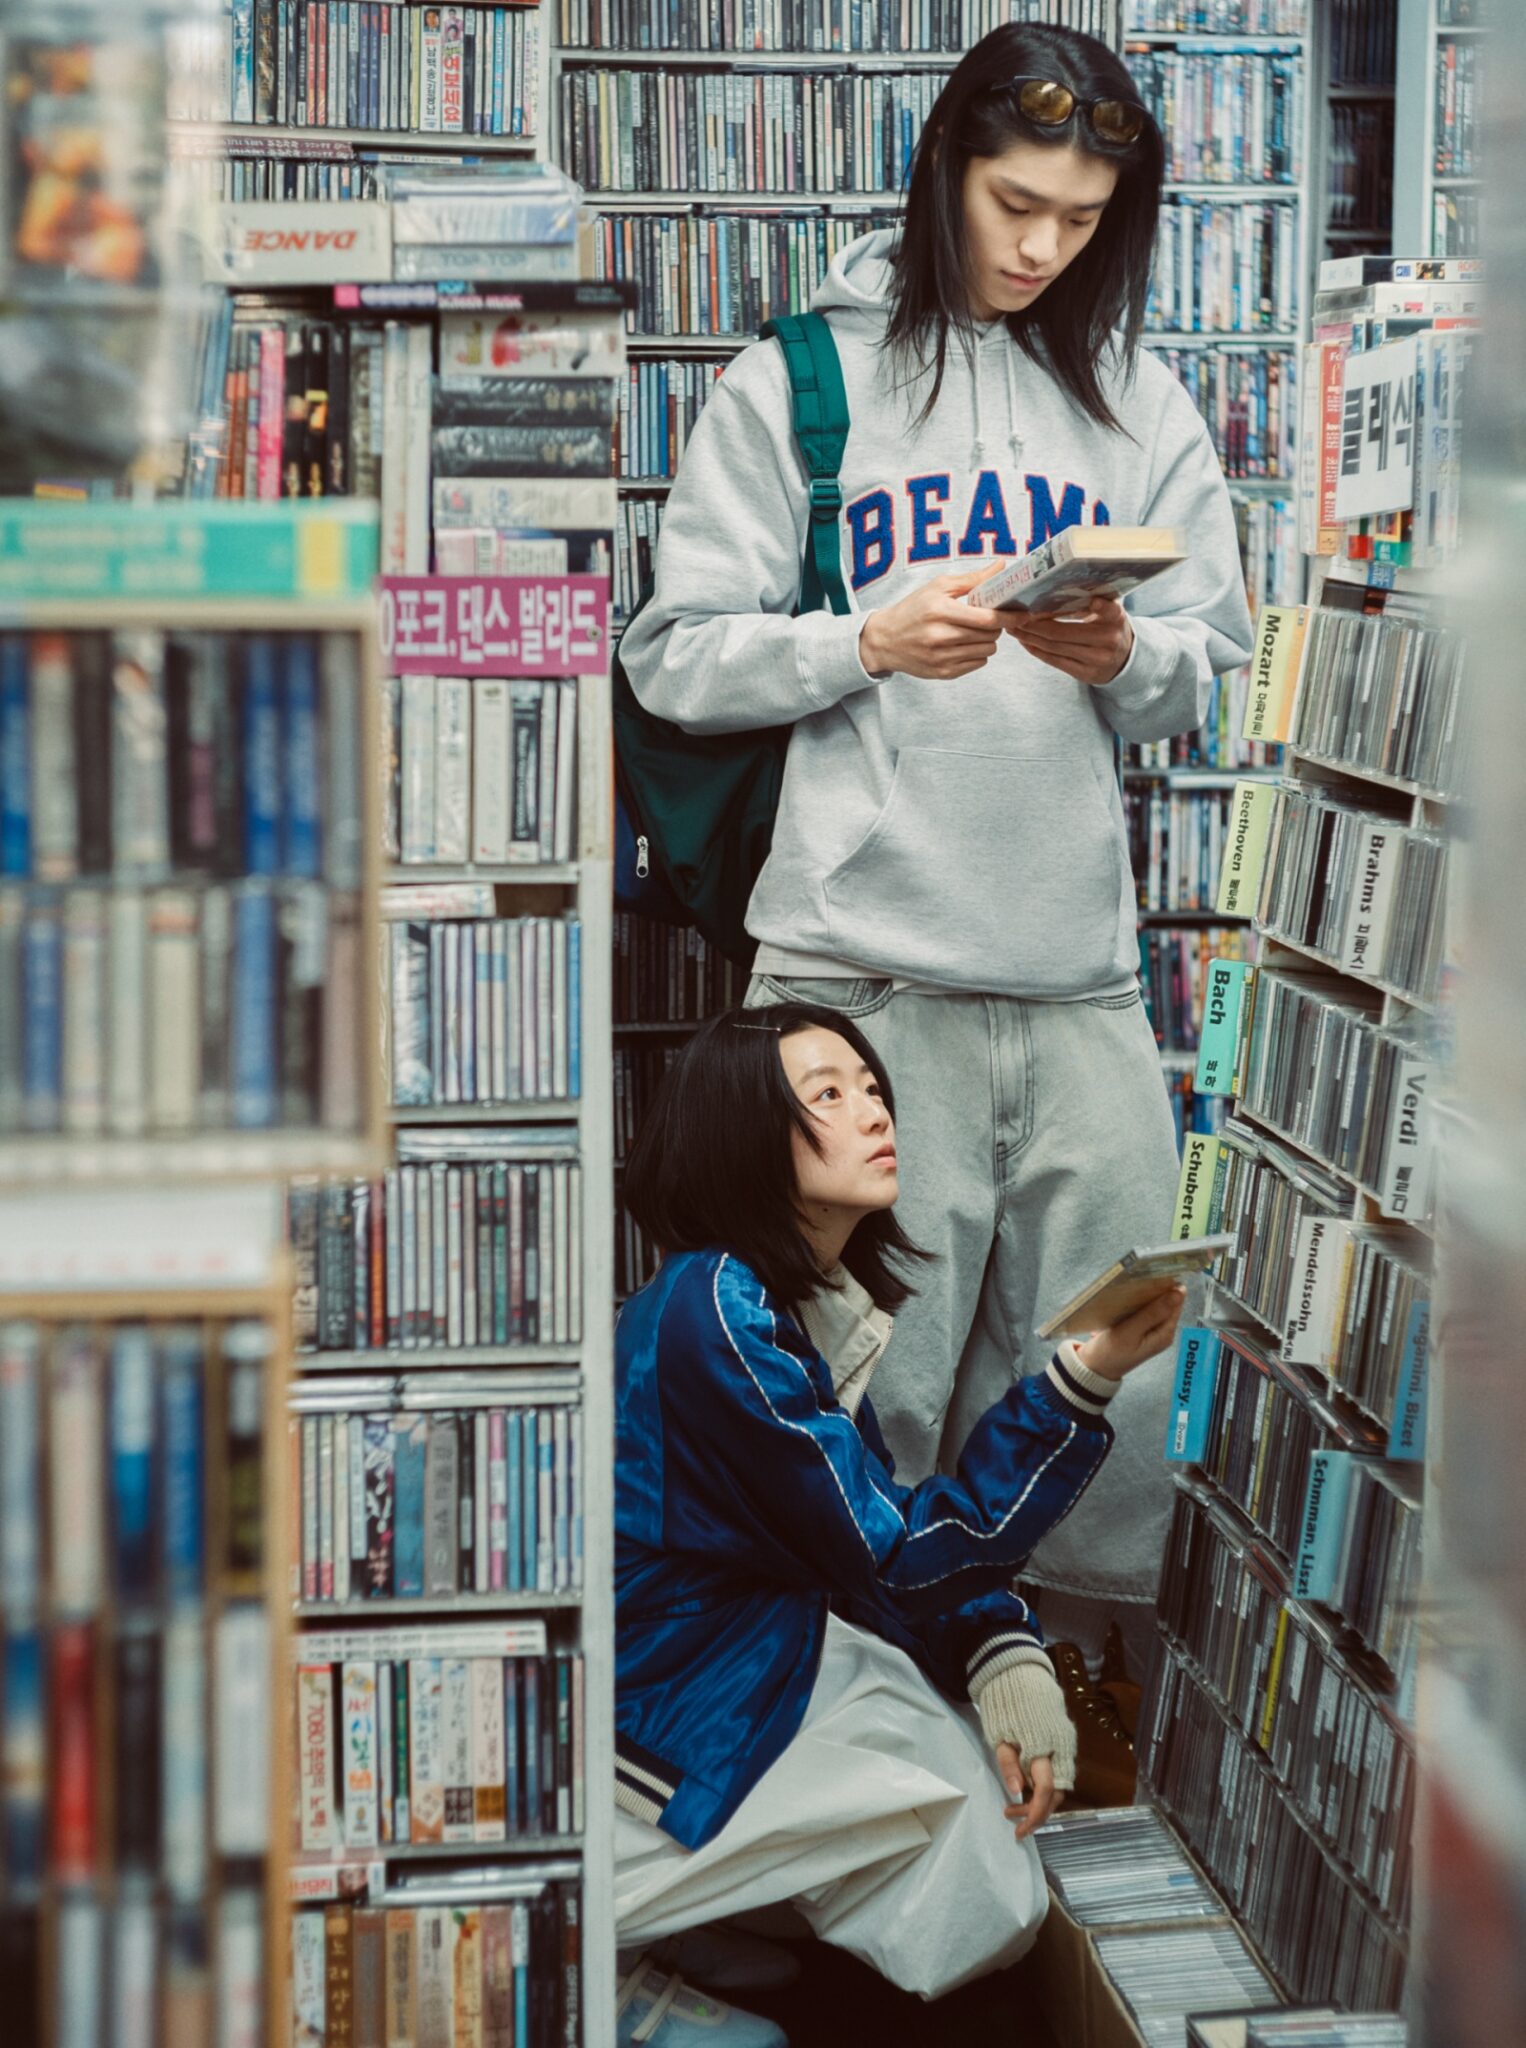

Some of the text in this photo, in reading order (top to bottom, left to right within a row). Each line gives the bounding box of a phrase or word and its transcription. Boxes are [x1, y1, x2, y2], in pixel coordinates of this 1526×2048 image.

[243, 229, 358, 253] DANCE
[1341, 374, 1413, 477] 클래식
[1257, 614, 1281, 688] Mozart
[1251, 692, 1268, 735] 모짜르트
[1231, 789, 1254, 872] Beethoven
[1225, 878, 1241, 912] 베토벤
[1359, 834, 1386, 915] Brahms
[1349, 923, 1372, 970] 브람스
[1209, 969, 1231, 1025] Bach
[1204, 1059, 1218, 1088] 바하
[1398, 1073, 1427, 1146] Verdi
[1181, 1140, 1206, 1222] Schubert
[1391, 1166, 1414, 1214] 베르디
[1297, 1222, 1325, 1332] Mendelssohn
[1179, 1339, 1200, 1408] Debussy.
[1400, 1401, 1420, 1448] Bizet
[1297, 1458, 1328, 1596] Schmman. Liszt
